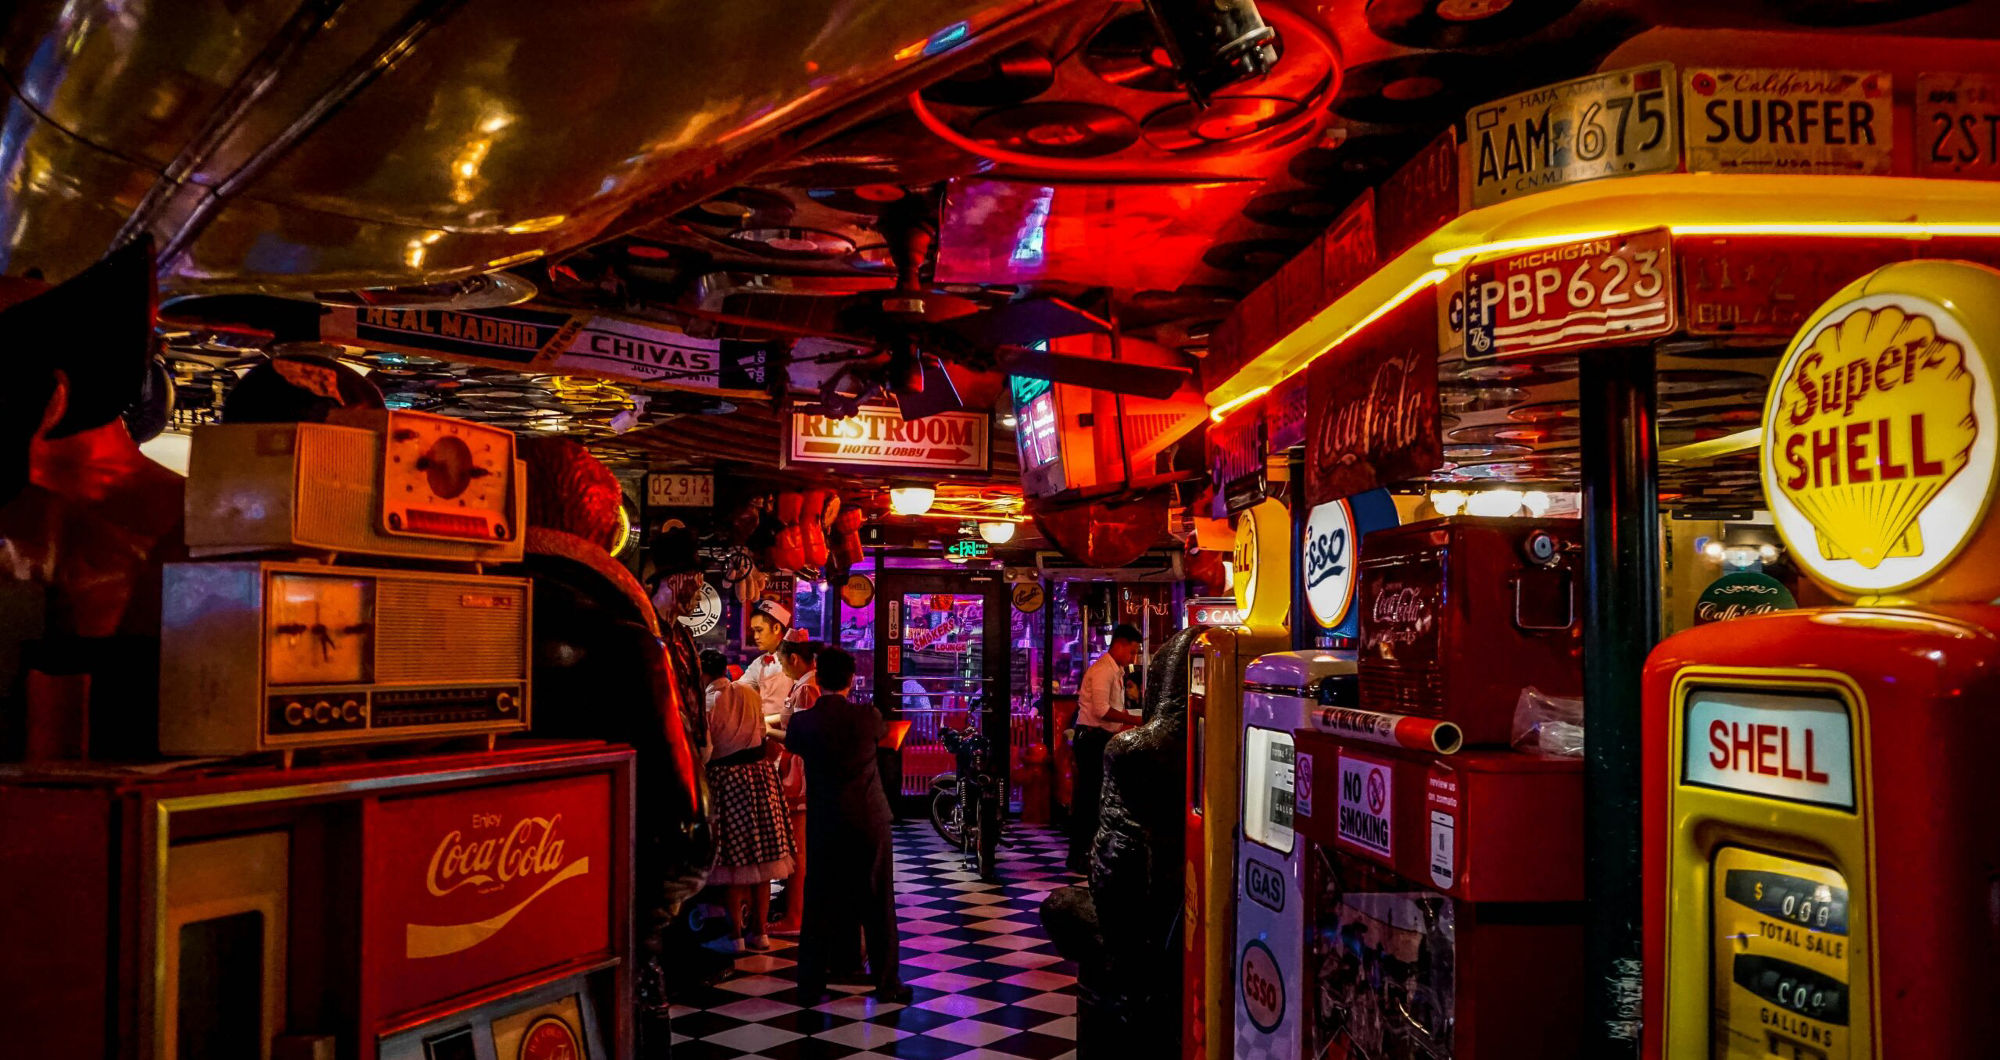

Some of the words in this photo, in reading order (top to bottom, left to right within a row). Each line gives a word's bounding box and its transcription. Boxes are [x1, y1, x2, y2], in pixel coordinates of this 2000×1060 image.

[1478, 104, 1551, 187] AAM
[1576, 90, 1666, 162] 675
[1705, 99, 1876, 145] SURFER
[1775, 158, 1812, 168] USA
[1508, 240, 1613, 270] MICHIGAN
[367, 307, 435, 334] REAL
[441, 313, 538, 349] MADRID
[1468, 327, 1492, 352] 76
[590, 335, 711, 371] CHIVAS
[632, 365, 658, 376] JULY
[1787, 336, 1930, 428] Super
[801, 412, 975, 447] RESTROOM
[843, 444, 882, 456] HOTEL
[884, 447, 926, 458] LOBBY
[1784, 413, 1946, 492] SHELL
[913, 618, 955, 651] SMOKERS
[936, 643, 967, 652] LOUNGE
[1707, 719, 1828, 785] SHELL
[1344, 770, 1362, 804] NO
[472, 813, 502, 829] Enjoy
[1340, 805, 1389, 847] SMOKING
[426, 812, 565, 898] Coca-Cola
[1253, 868, 1278, 905] GAS
[1758, 920, 1801, 947] TOTAL
[1804, 934, 1844, 960] SALE
[1246, 960, 1277, 1012] ESSO
[1760, 1007, 1833, 1048] GALLONS
